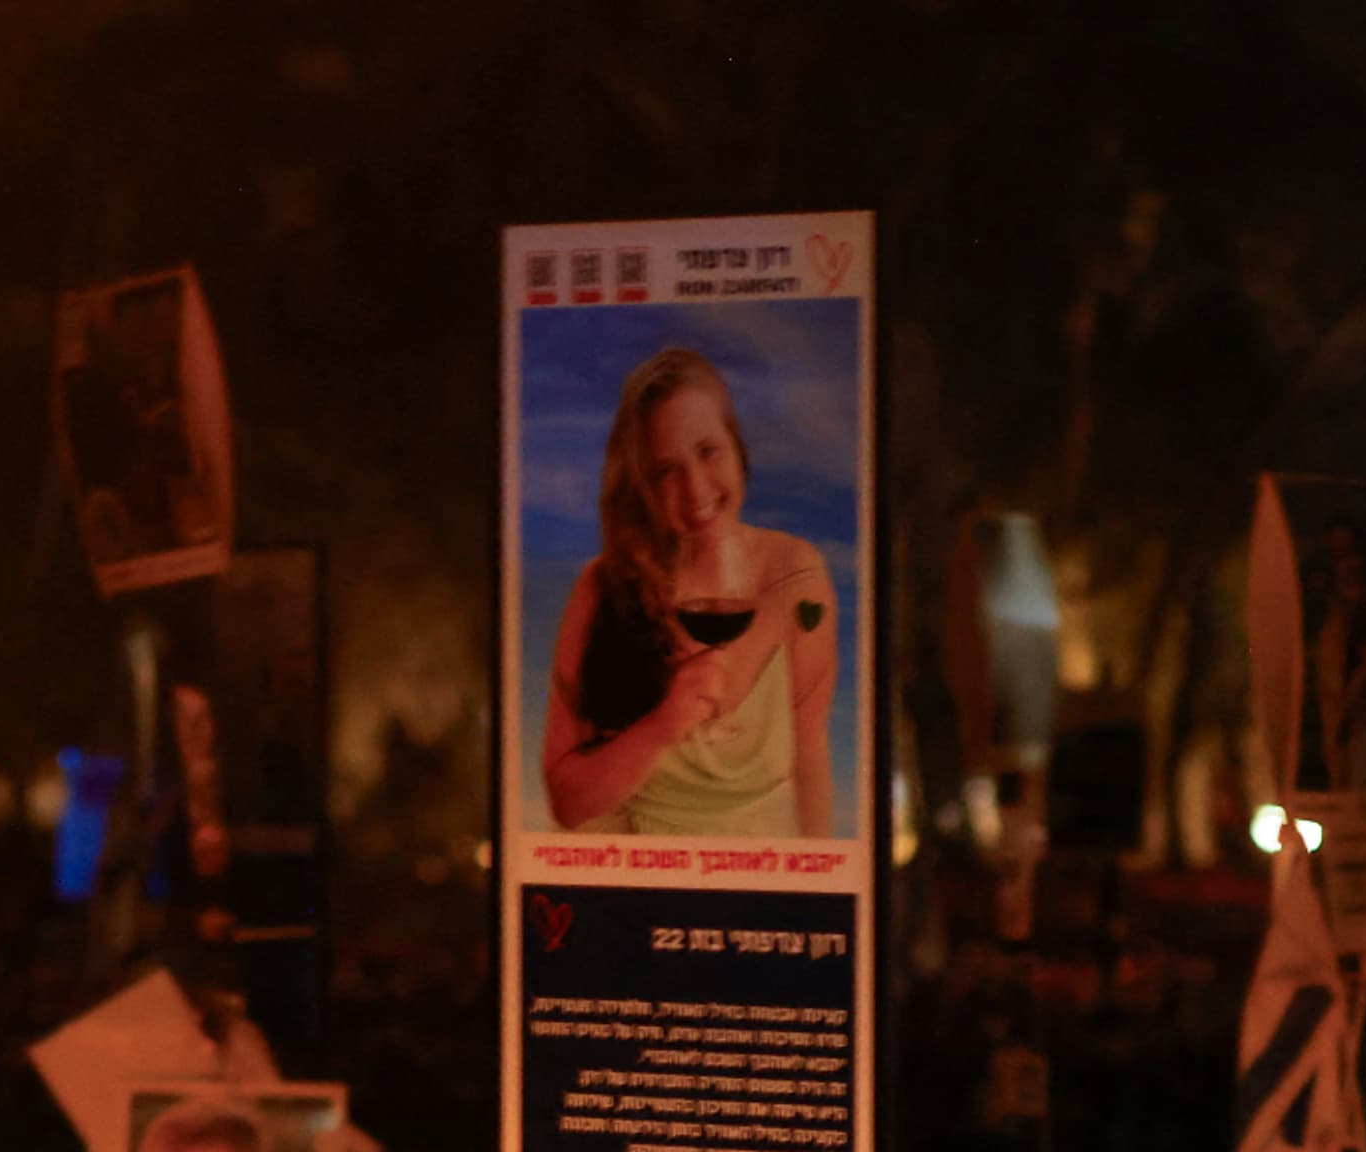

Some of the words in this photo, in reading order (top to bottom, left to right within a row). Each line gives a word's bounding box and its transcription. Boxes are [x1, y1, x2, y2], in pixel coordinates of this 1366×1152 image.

[756, 246, 792, 271] רון
[676, 280, 718, 297] RON
[652, 927, 685, 950] 22
[689, 929, 727, 952] בת
[731, 930, 806, 954] צרפתי
[810, 933, 847, 959] רון
